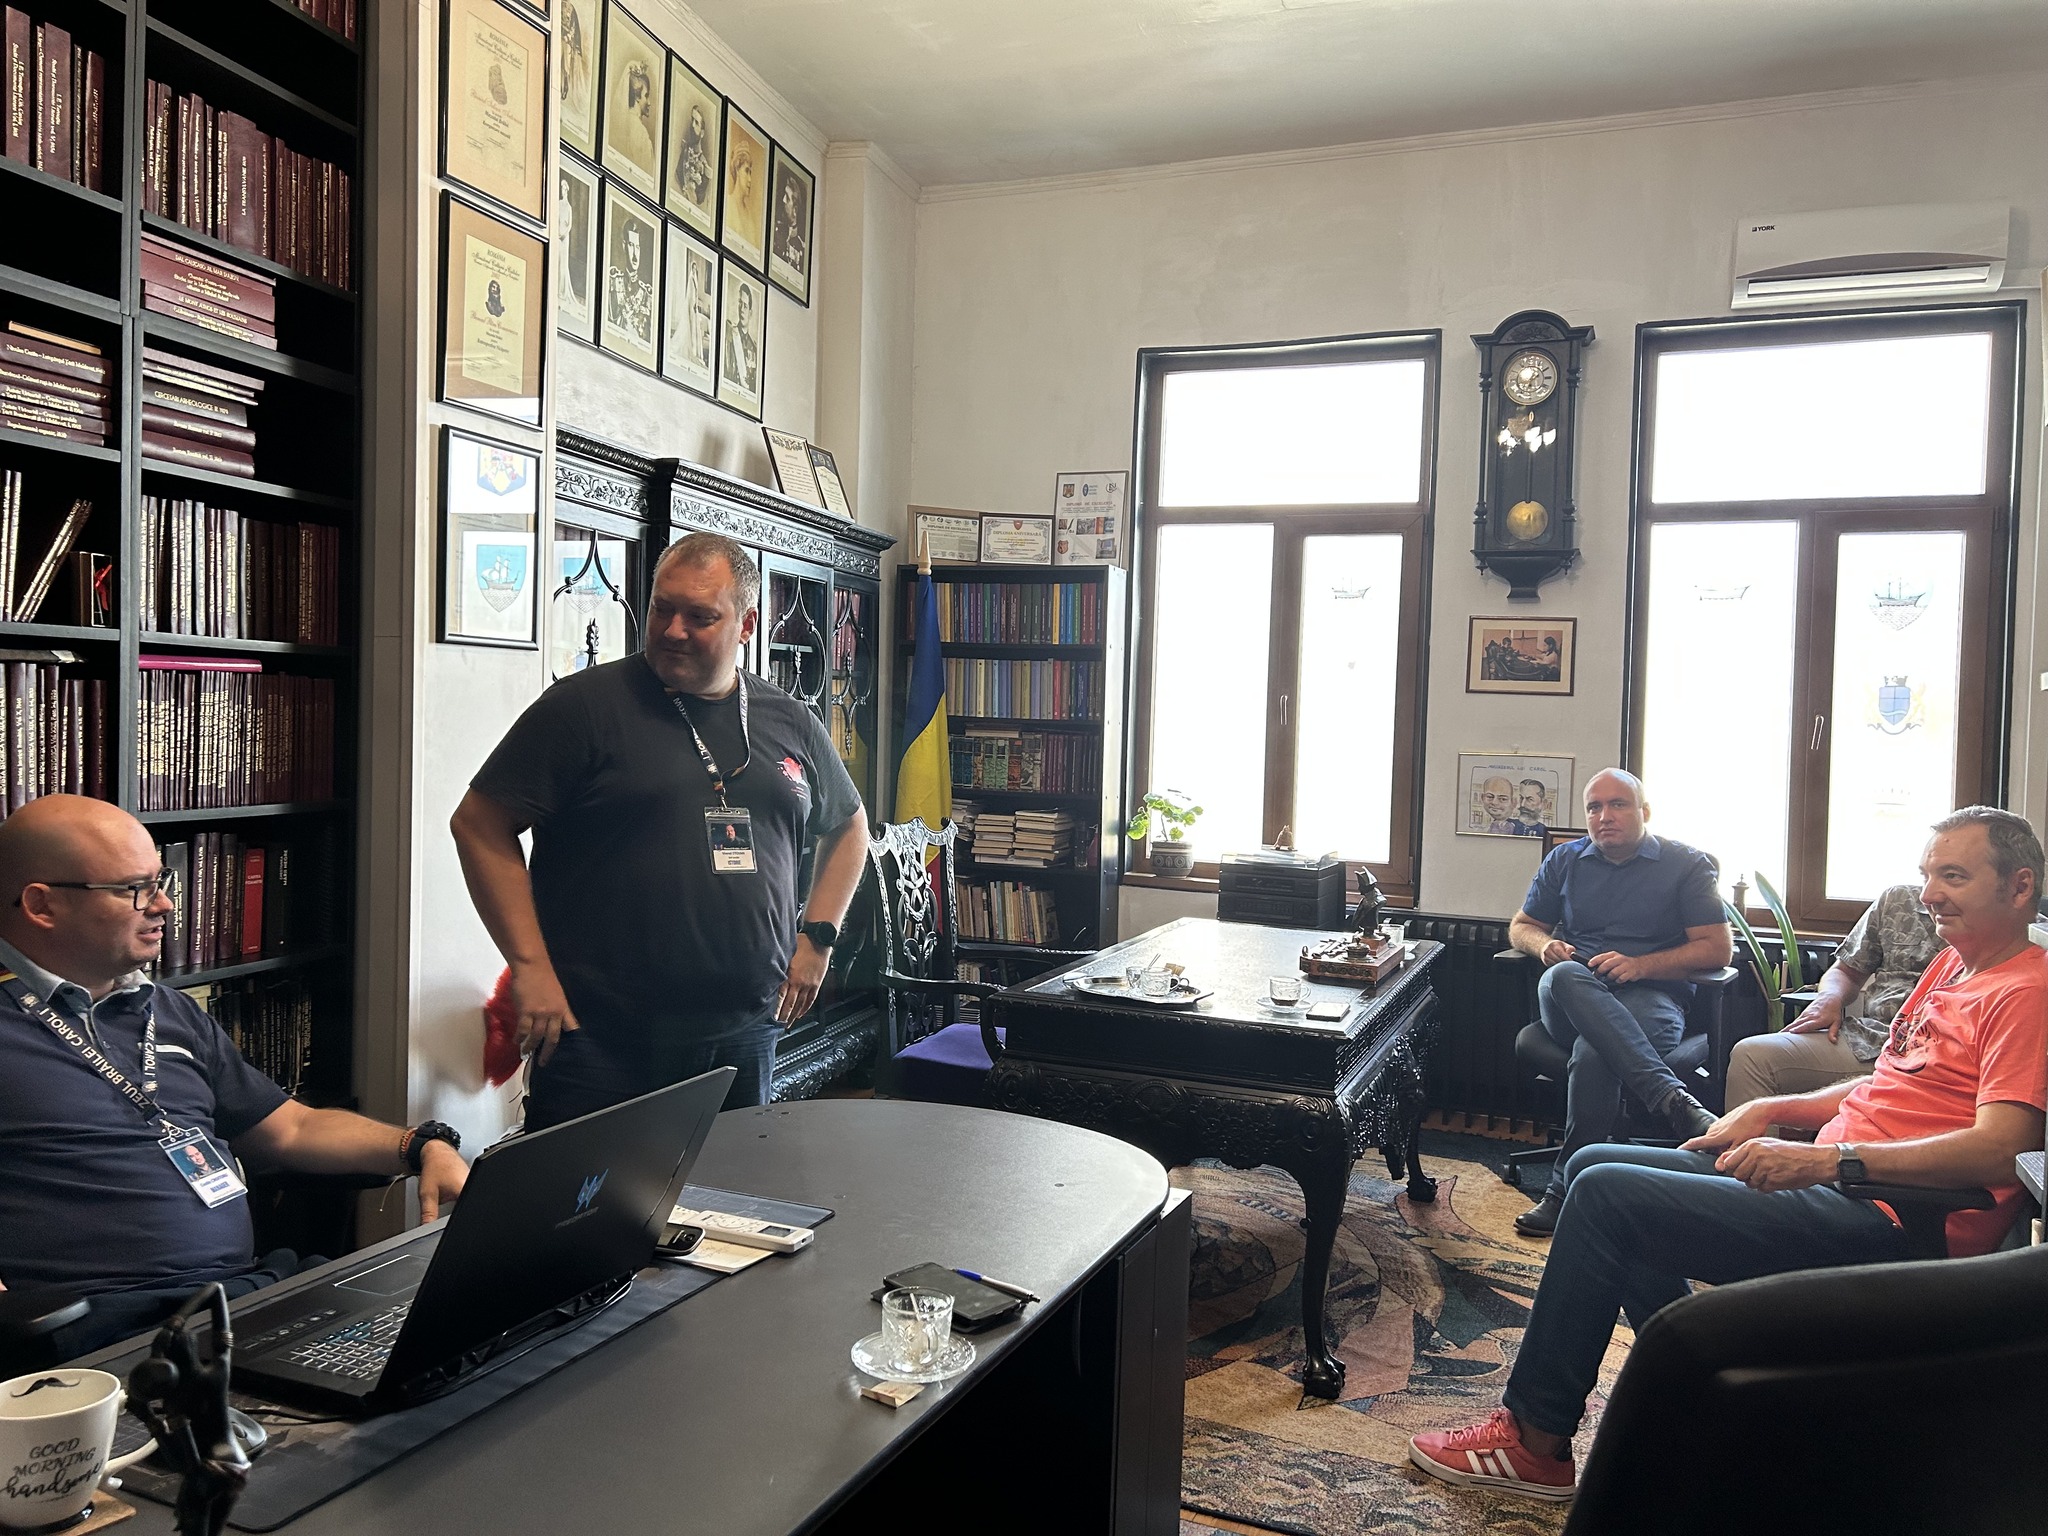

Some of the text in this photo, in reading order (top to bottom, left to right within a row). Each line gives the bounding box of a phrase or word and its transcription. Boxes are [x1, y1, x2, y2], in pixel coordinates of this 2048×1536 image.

[82, 1046, 125, 1085] BRĂILEI
[14, 1447, 96, 1476] MORNING
[30, 1438, 80, 1459] GOOD
